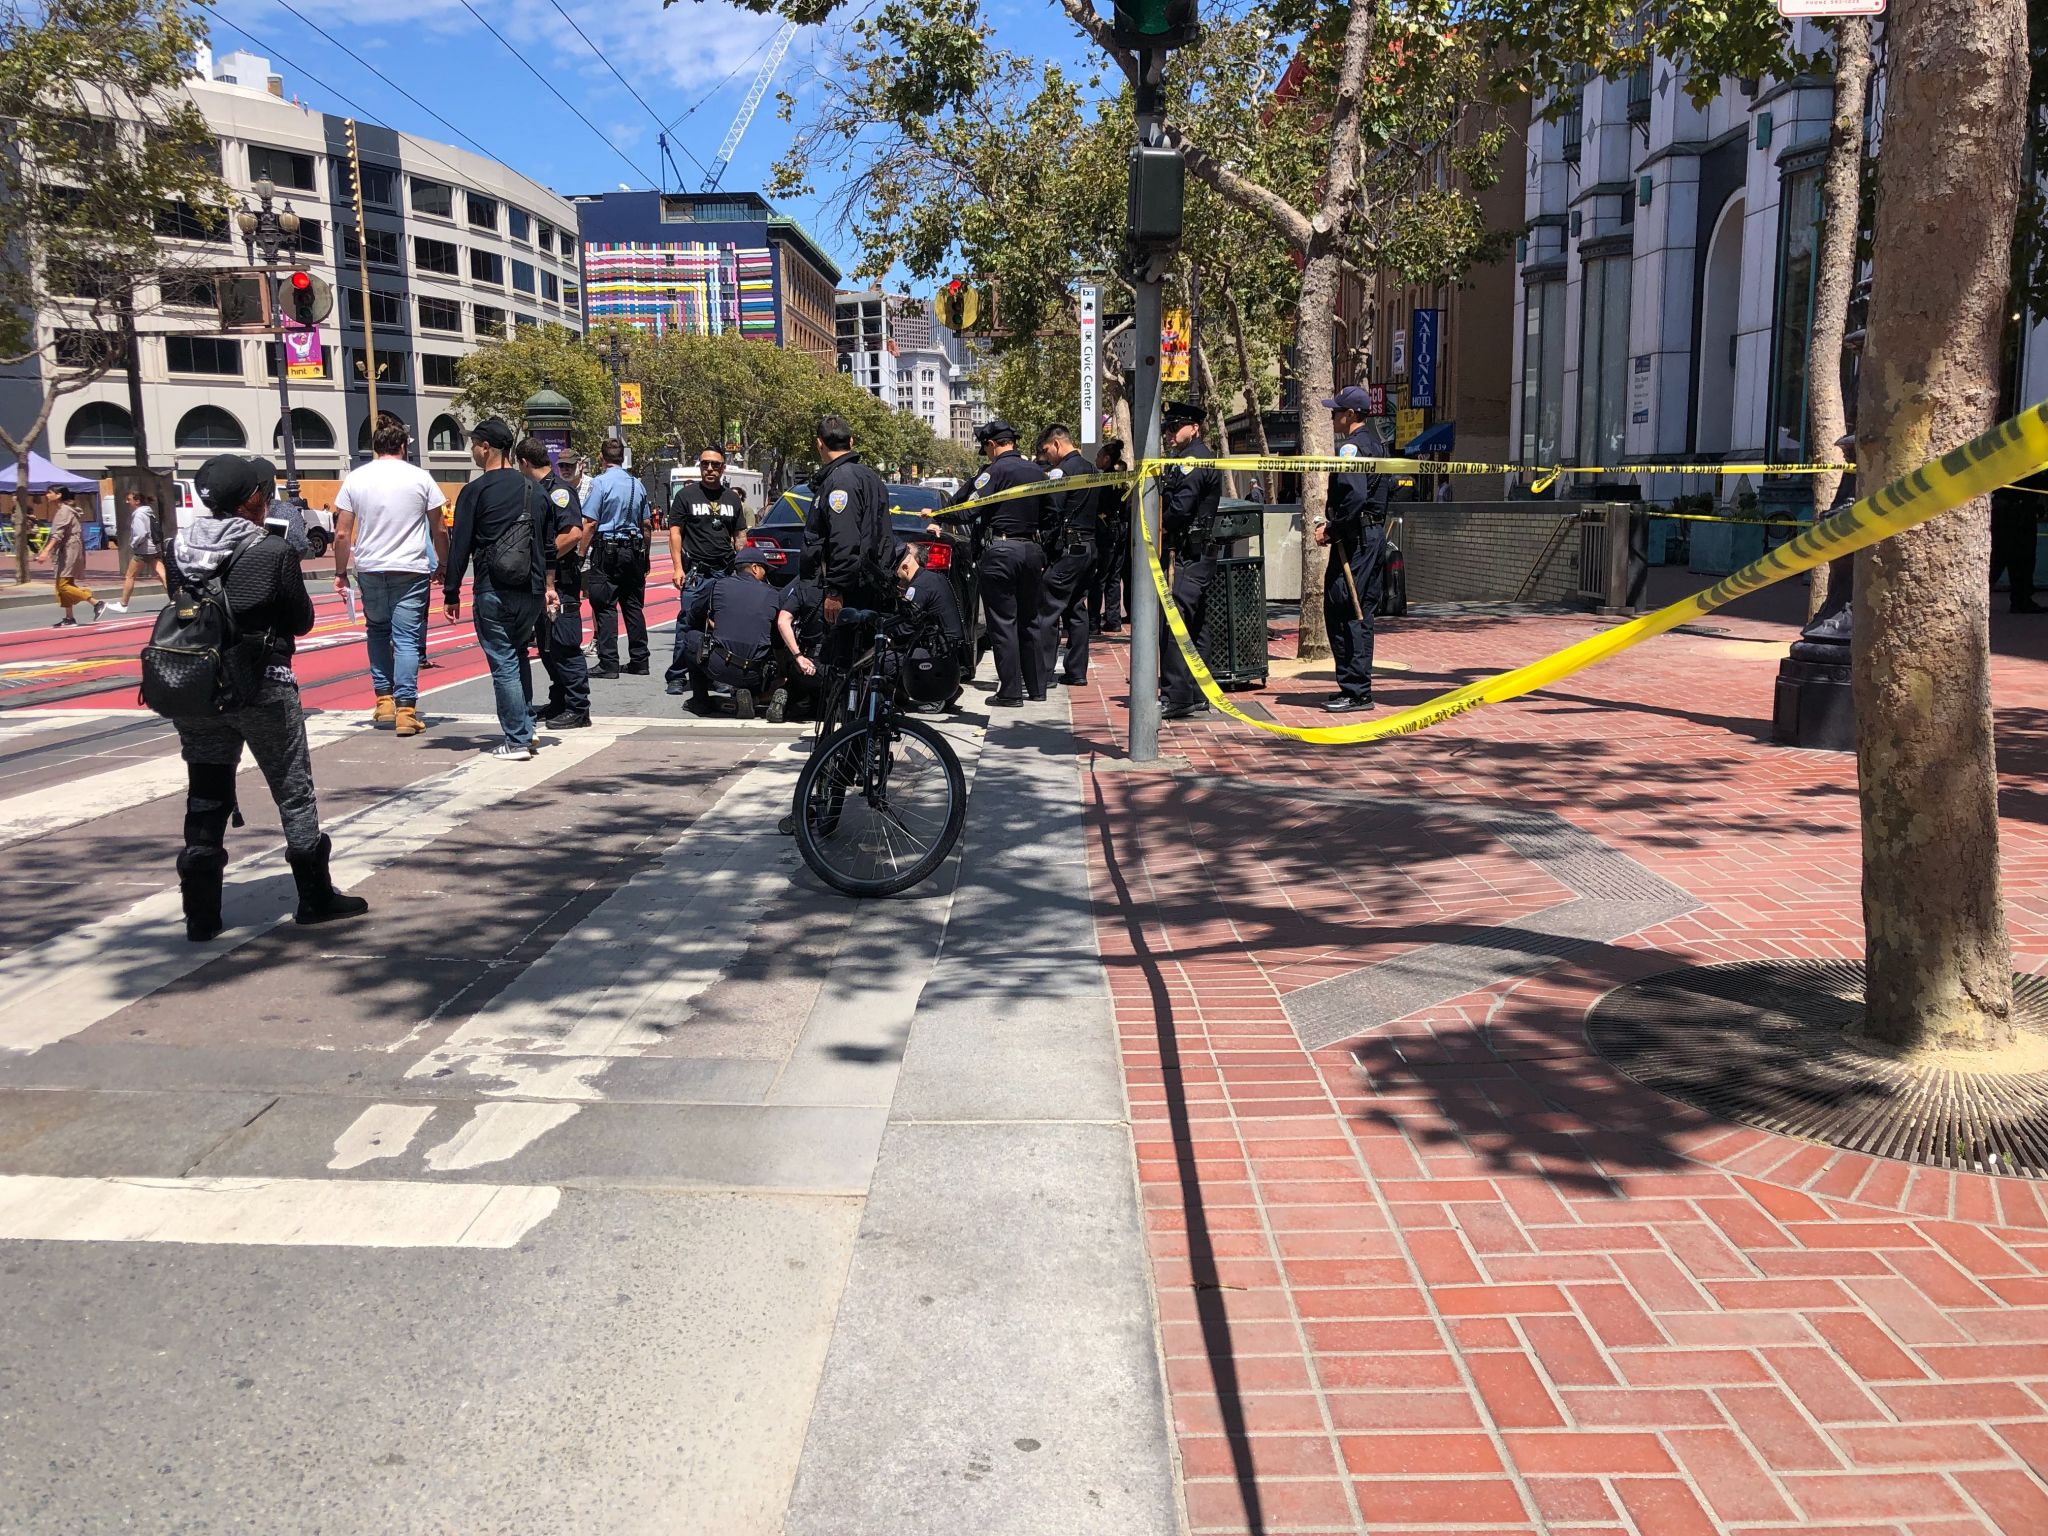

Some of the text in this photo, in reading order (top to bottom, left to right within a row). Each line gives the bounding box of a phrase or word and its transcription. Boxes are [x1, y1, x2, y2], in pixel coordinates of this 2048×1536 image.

[1417, 311, 1431, 396] NATIONAL
[1084, 346, 1093, 411] Civic Center
[1412, 396, 1433, 407] HOTEL
[1429, 443, 1447, 451] 1139
[1257, 459, 1377, 473] POLICE LINE DO NOT CROSS
[1418, 462, 1448, 473] CROSS
[1450, 462, 1468, 473] NOT
[1471, 463, 1483, 474] DO
[1485, 463, 1505, 474] LINE
